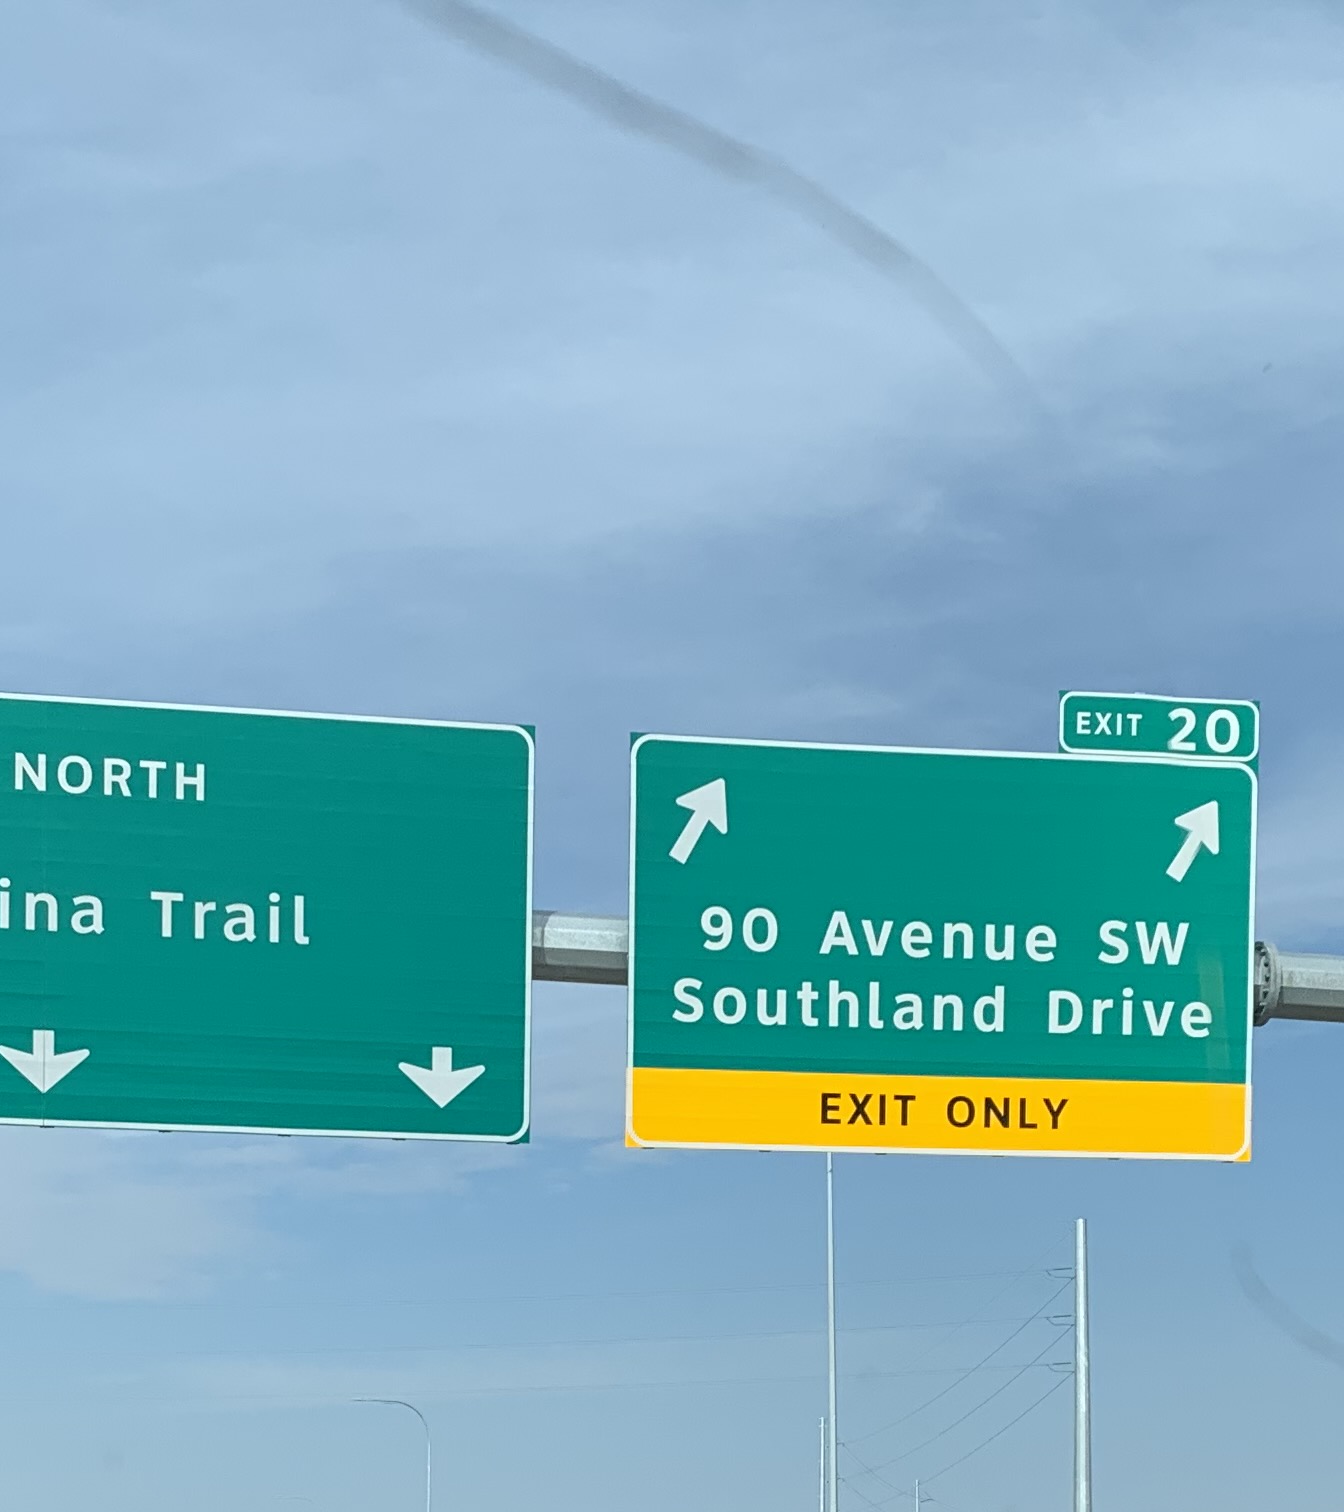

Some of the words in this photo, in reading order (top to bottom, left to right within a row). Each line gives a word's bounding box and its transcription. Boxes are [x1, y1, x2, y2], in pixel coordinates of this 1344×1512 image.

[1076, 711, 1143, 738] EXIT
[1167, 707, 1241, 754] 20
[14, 752, 205, 801] NORTH
[150, 891, 310, 945] Trail
[700, 905, 778, 953] 90
[819, 910, 1057, 962] Avenue
[1098, 919, 1190, 966] SW
[672, 977, 1005, 1033] Southland
[1048, 987, 1212, 1038] Drive
[820, 1092, 916, 1127] EXIT
[946, 1095, 1069, 1130] ONLY
